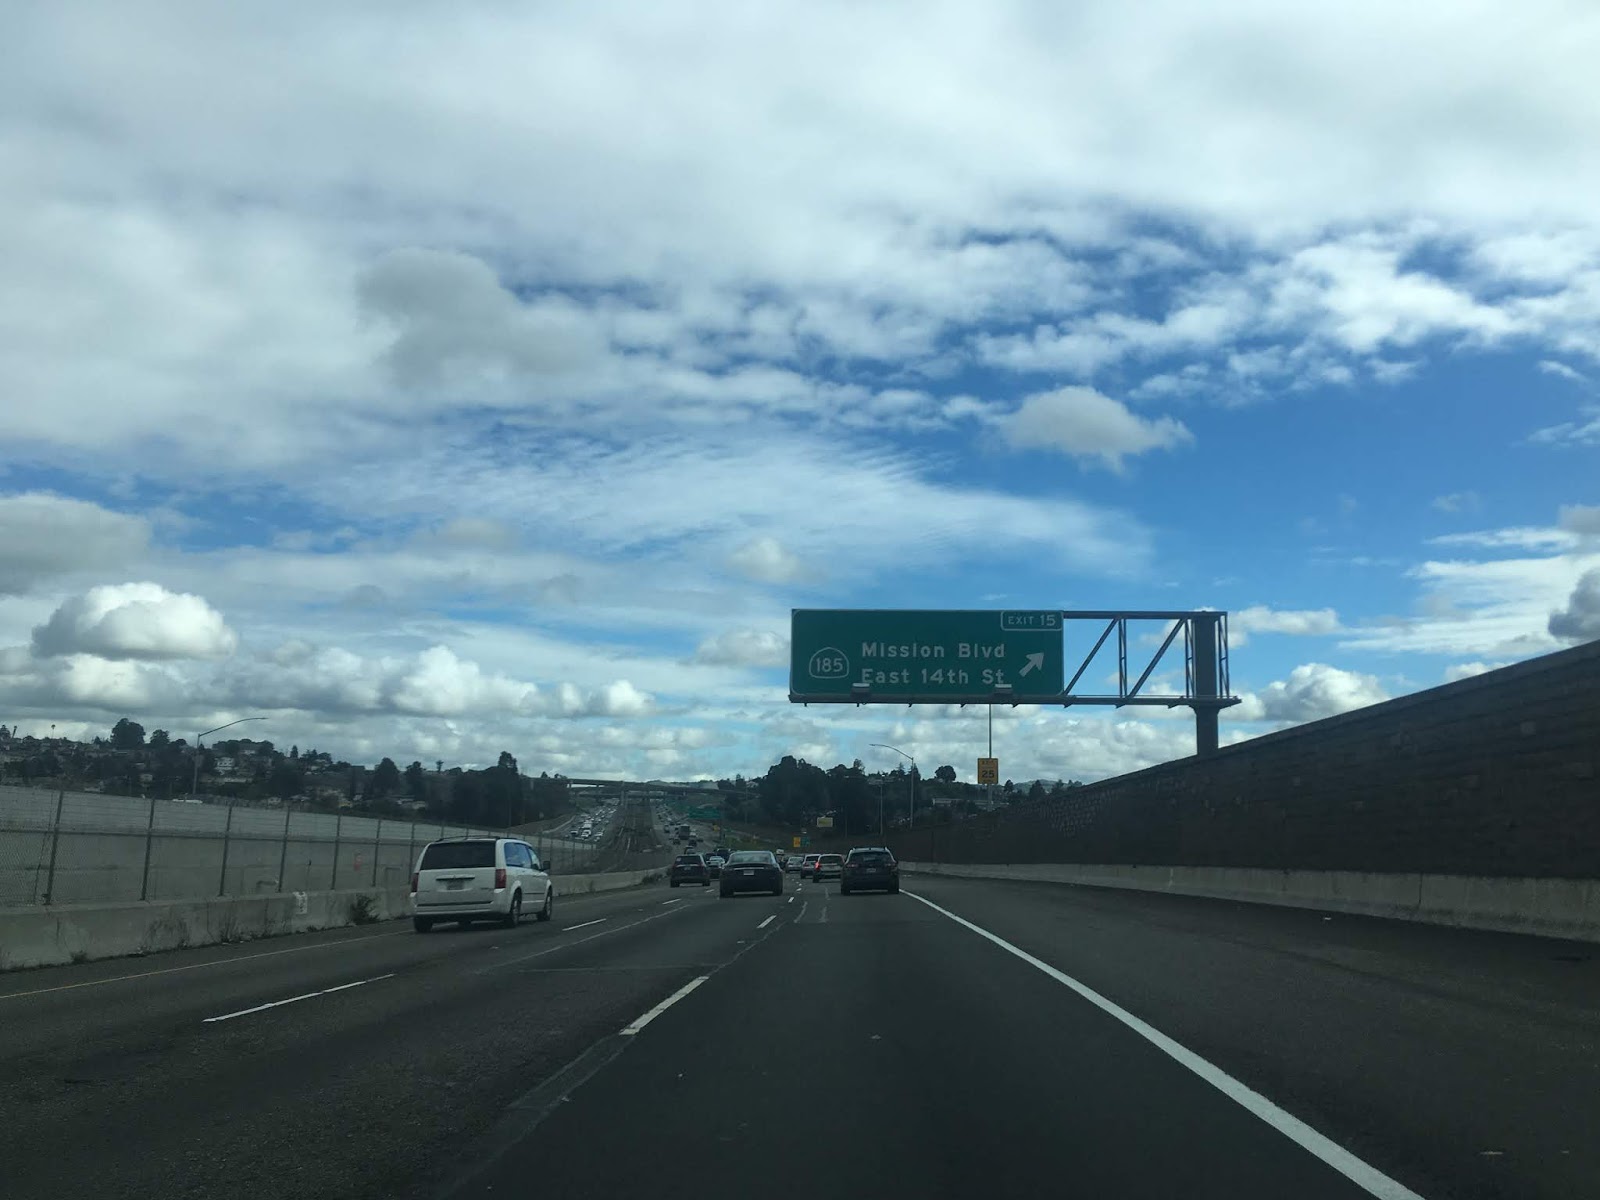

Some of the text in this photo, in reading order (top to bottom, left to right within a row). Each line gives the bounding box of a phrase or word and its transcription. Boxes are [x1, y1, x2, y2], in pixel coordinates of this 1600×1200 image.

[1007, 613, 1056, 626] EXIT 15
[861, 642, 1006, 658] Mission Blvd
[816, 657, 844, 673] 185
[861, 667, 1004, 684] East 14th St
[982, 769, 995, 779] 25
